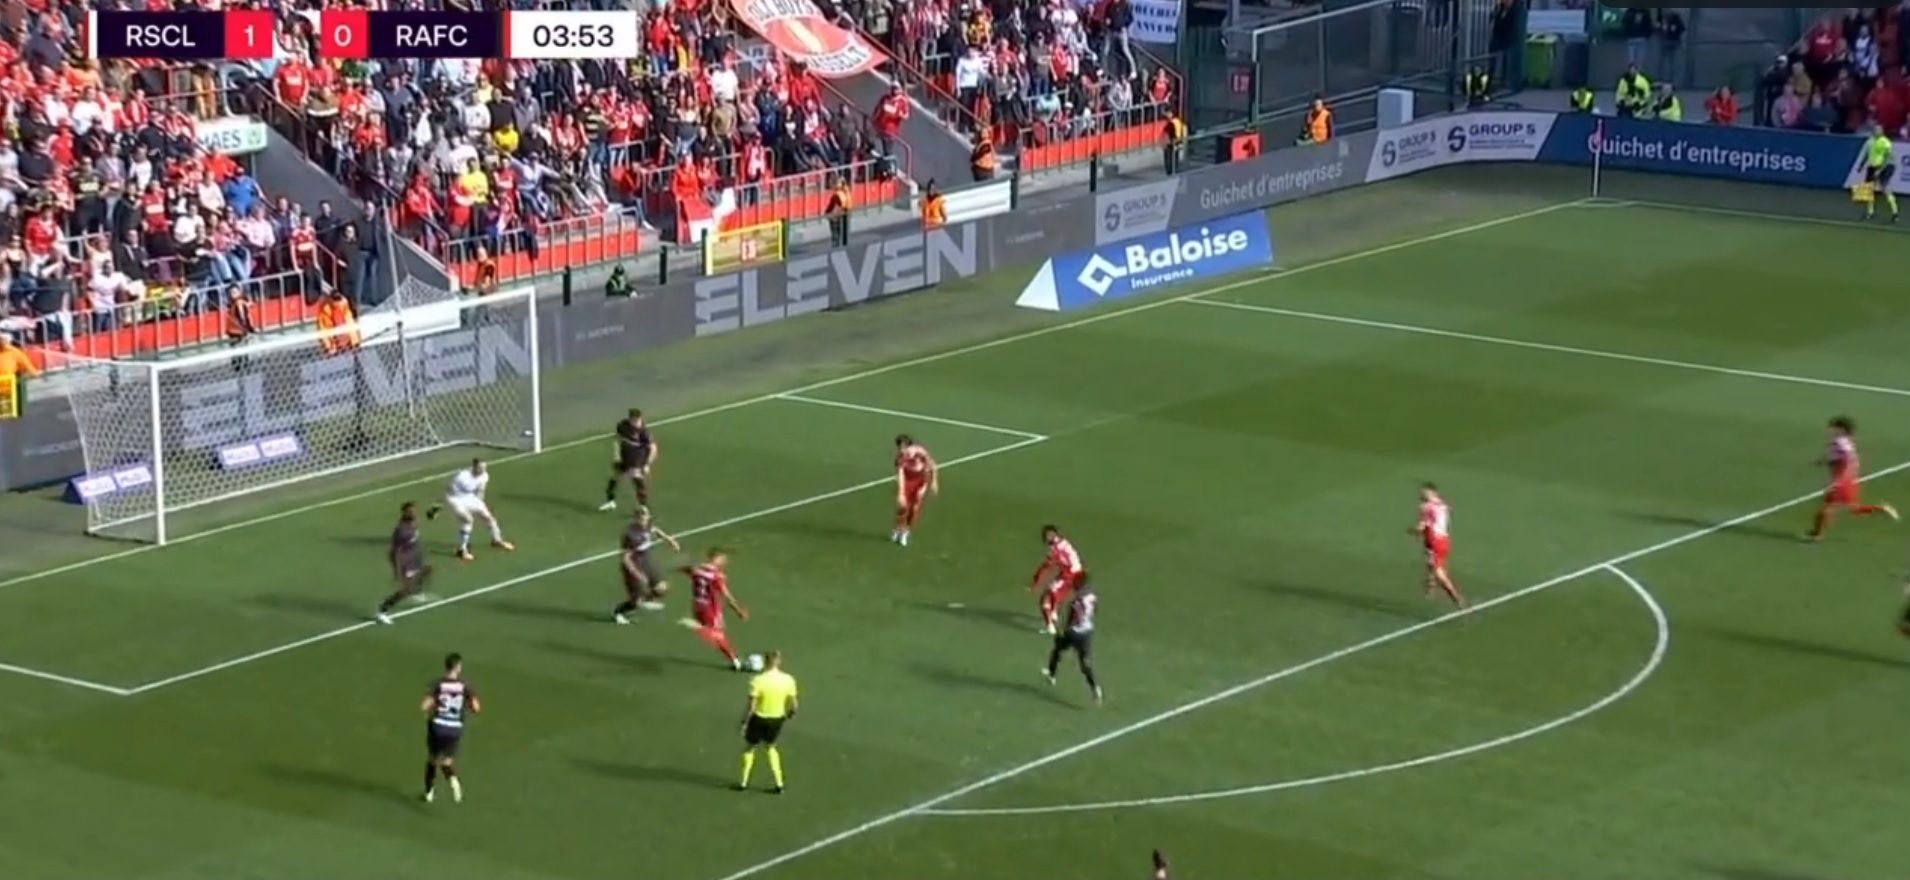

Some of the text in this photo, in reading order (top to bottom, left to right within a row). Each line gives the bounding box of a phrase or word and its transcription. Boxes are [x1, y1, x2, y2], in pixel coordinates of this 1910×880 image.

[1399, 132, 1429, 149] GROUP
[1469, 124, 1536, 137] GROUP S
[1587, 132, 1664, 159] Guichet
[1123, 195, 1160, 213] GROUP
[1200, 178, 1255, 210] Guichet
[1125, 227, 1249, 274] Baloise
[694, 222, 977, 337] ELEVEN
[1131, 267, 1195, 289] Insurance
